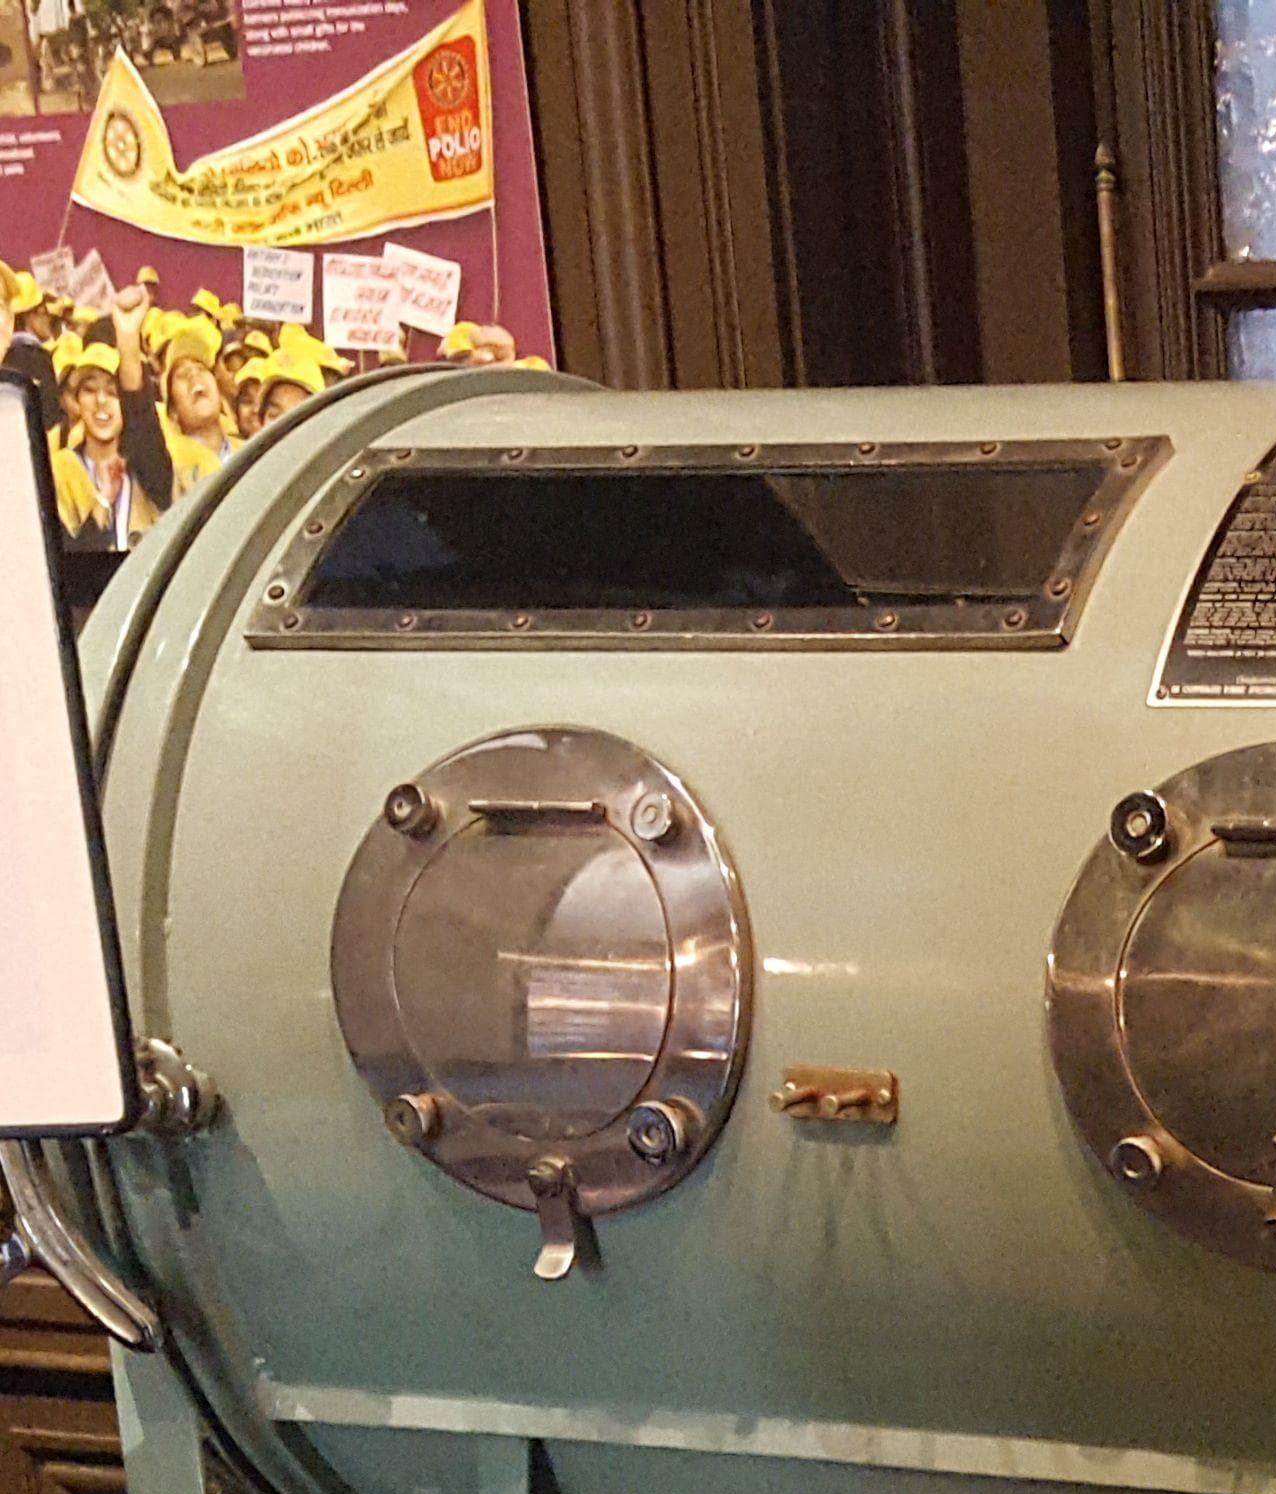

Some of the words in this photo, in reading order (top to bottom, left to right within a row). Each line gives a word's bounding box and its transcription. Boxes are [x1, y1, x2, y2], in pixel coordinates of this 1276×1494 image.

[434, 109, 472, 135] END
[428, 126, 481, 163] POLIO
[439, 151, 478, 177] NOW
